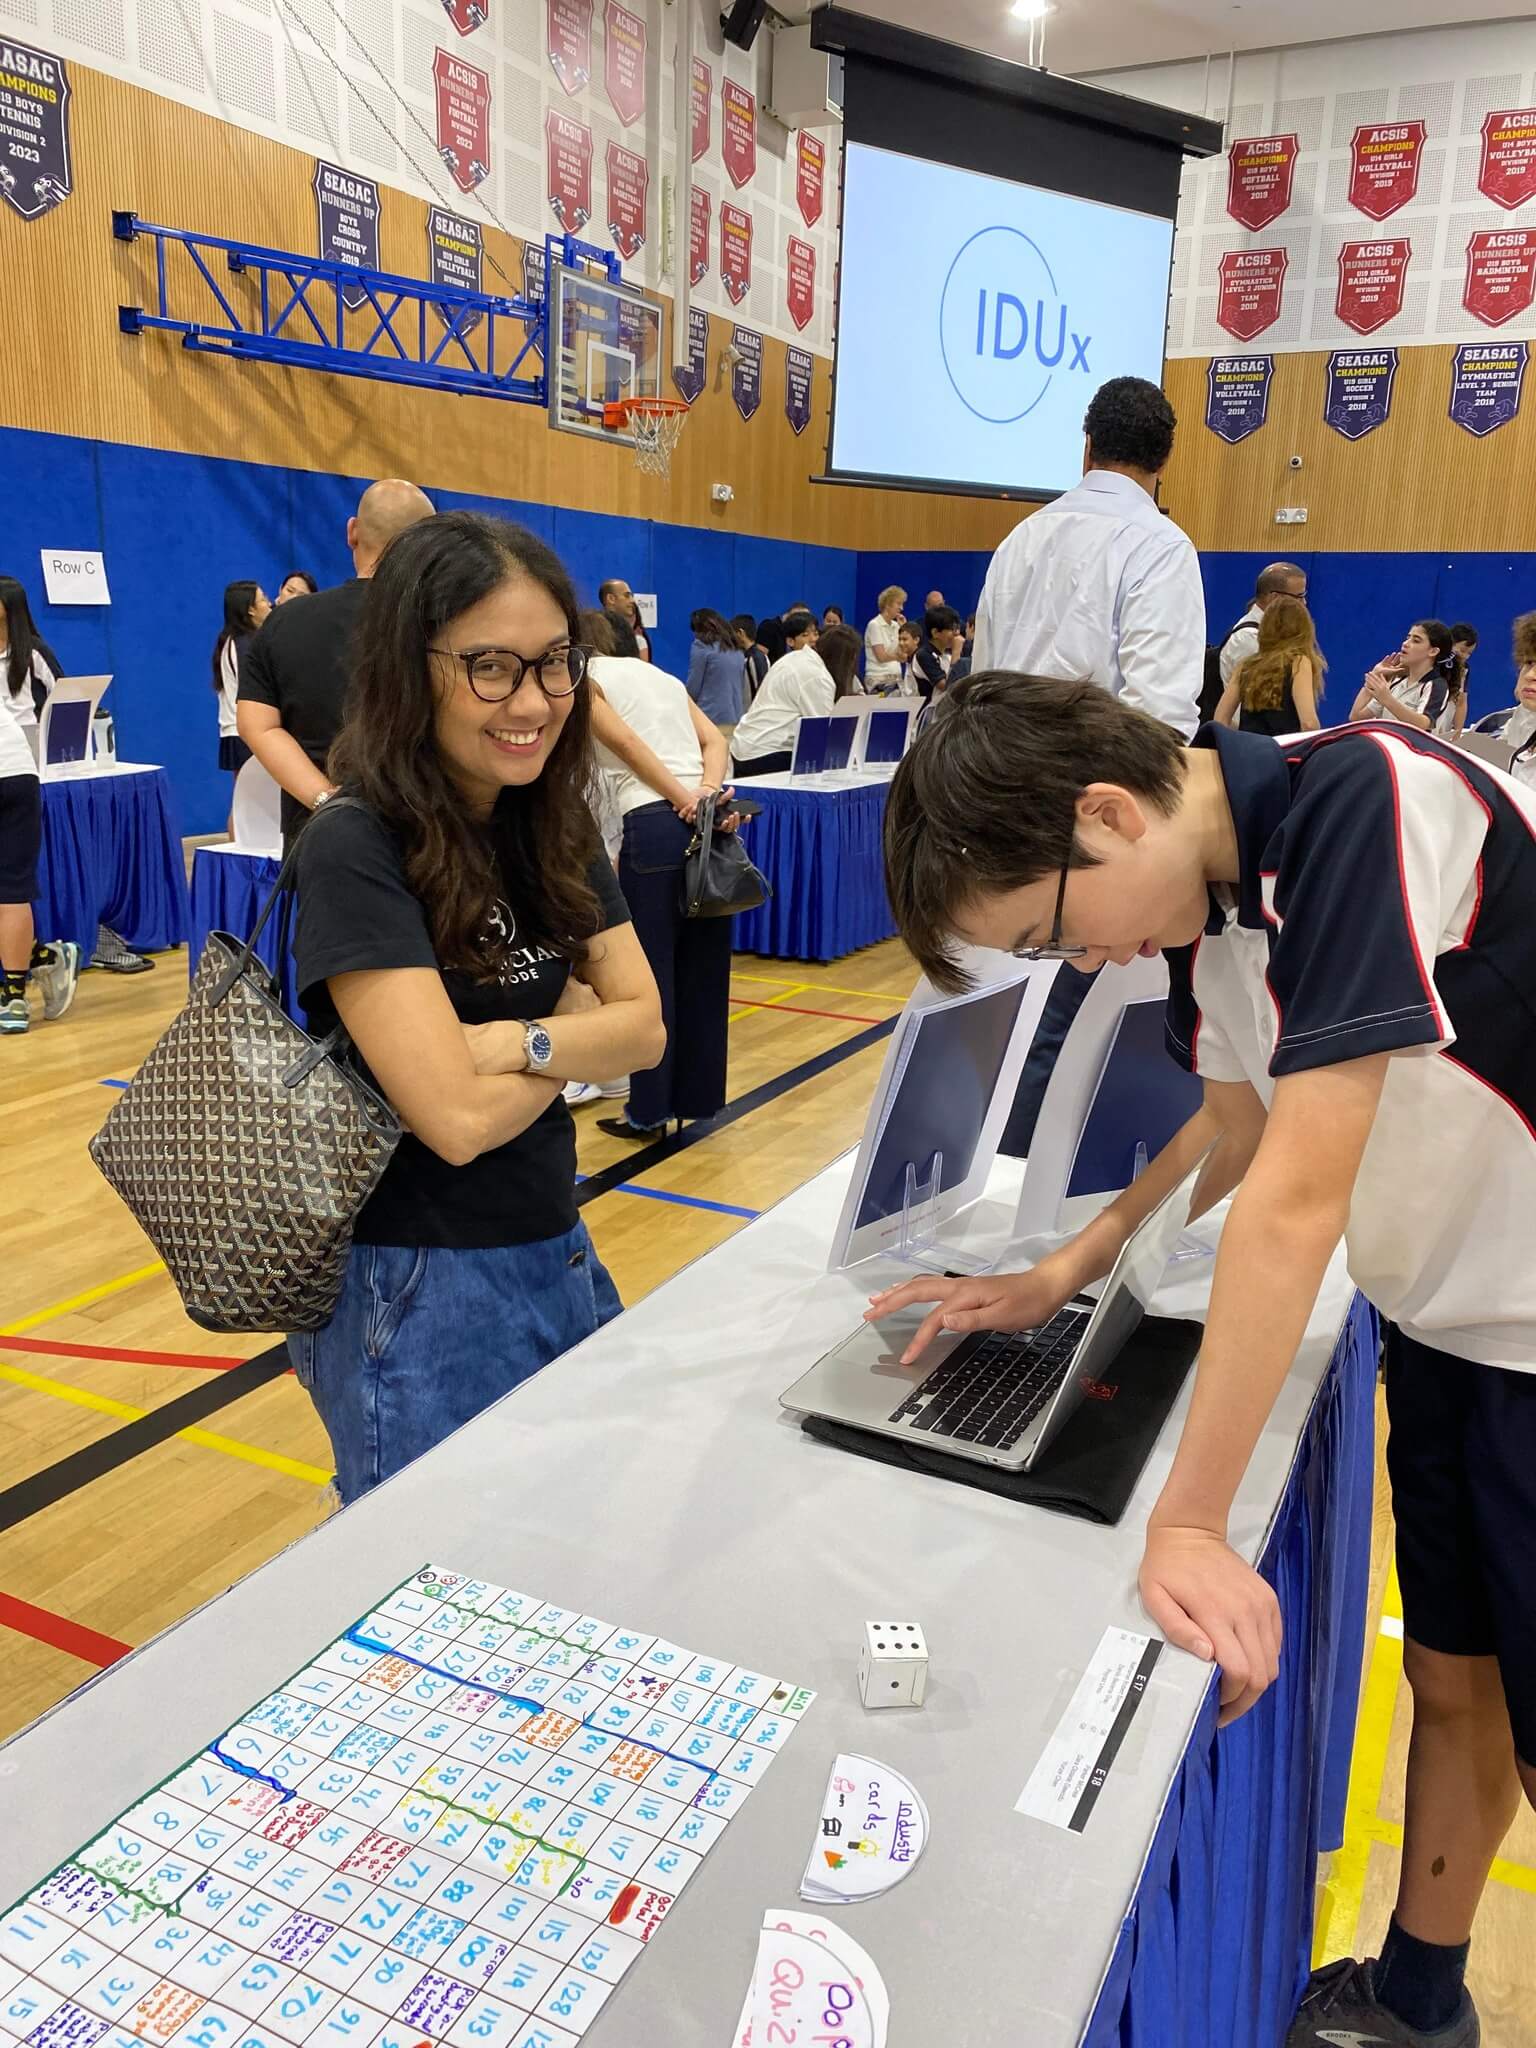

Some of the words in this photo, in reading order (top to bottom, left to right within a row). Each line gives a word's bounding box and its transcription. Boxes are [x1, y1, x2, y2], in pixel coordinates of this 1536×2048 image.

[2, 48, 55, 83] ASAC
[448, 62, 478, 89] ACSIS
[0, 72, 57, 103] AMPIONS
[15, 96, 44, 116] BOYS
[0, 106, 41, 129] TENNIS
[40, 137, 46, 147] 2
[1369, 128, 1408, 142] ACSIS
[1492, 129, 1536, 140] CHAMPIO
[8, 142, 40, 163] 2023
[1247, 142, 1282, 155] ACSIS
[1361, 142, 1415, 154] CHAMPIONS
[1490, 149, 1536, 160] VOLLEYBA
[1239, 154, 1288, 166] CHAMPIONS
[1359, 161, 1413, 172] VOLLEYBALL
[1241, 174, 1280, 184] SOFTBALL
[1506, 166, 1526, 176] 2019
[324, 171, 372, 204] SEASAC
[321, 191, 362, 216] RUNNERS
[363, 206, 375, 220] UP
[338, 222, 361, 239] CROSS
[435, 215, 476, 243] SEASAC
[332, 235, 368, 255] COUNTRY
[1487, 234, 1527, 248] ACSIS
[528, 250, 545, 267] SEA
[1236, 255, 1271, 267] ACSIS
[1357, 245, 1394, 258] ACSIS
[1474, 249, 1520, 259] RUNNERS
[1523, 247, 1536, 256] UP
[437, 258, 477, 280] VOLLEYBALL
[1225, 268, 1265, 278] RUNNERS
[1269, 267, 1280, 275] UP
[1345, 259, 1387, 269] RUNNERS
[1391, 258, 1402, 266] UP
[1477, 265, 1529, 275] BADMINTON
[1348, 275, 1396, 285] BADMINTON
[1490, 285, 1510, 294] 2019
[976, 288, 1092, 374] IDUx
[1337, 354, 1388, 367] SEASAC
[1464, 348, 1519, 361] SEASAC
[1217, 360, 1265, 373] SEASAC
[1336, 367, 1387, 377] CHAMPIONS
[1462, 361, 1518, 371] CHAMPIONS
[1462, 372, 1515, 380] GYMNASTICS
[1216, 374, 1264, 382] CHAMPIONS
[1216, 390, 1261, 398] VOLLEYBALL
[53, 560, 80, 574] Row
[85, 561, 95, 575] C
[443, 1651, 476, 1673] 29
[486, 1665, 510, 1683] 50
[300, 1681, 333, 1694] 4
[416, 1675, 446, 1698] 30
[340, 1691, 372, 1710] 22
[381, 1705, 413, 1722] 31
[604, 1706, 630, 1726] 83
[310, 1720, 339, 1738] 21
[579, 1734, 606, 1753] 84
[272, 1753, 307, 1778] 20
[392, 1752, 416, 1774] 47
[497, 1748, 530, 1765] 76
[201, 1775, 223, 1796] 7
[319, 1773, 353, 1793] 33
[438, 1766, 464, 1785] 58
[548, 1766, 573, 1785] 85
[663, 1767, 688, 1787] 119
[472, 1781, 501, 1801] 75
[636, 1798, 663, 1820] 118
[863, 1780, 887, 1830] cards
[404, 1807, 432, 1832] 59
[558, 1811, 588, 1837] 103
[195, 1828, 225, 1849] 19
[318, 1826, 350, 1846] 45
[436, 1823, 468, 1846] 74
[483, 1837, 506, 1861] 87
[608, 1836, 634, 1861] 117
[157, 1863, 187, 1882] 18
[272, 1867, 308, 1891] 44
[394, 1861, 430, 1888] 73
[196, 1875, 214, 1893] top
[442, 1880, 474, 1903] 88
[571, 1877, 592, 1898] top
[594, 1879, 620, 1901] 116
[104, 1903, 131, 1926] 17
[360, 1898, 401, 1929] 72
[658, 1896, 672, 1913] go
[238, 1902, 272, 1928] 43
[9, 1914, 48, 1941] 11
[539, 1920, 571, 1943] 115
[155, 1928, 189, 1951] 36
[60, 1948, 90, 1969] 16
[330, 1942, 362, 1966] 71
[459, 1936, 493, 1967] 100
[581, 1942, 609, 1971] 129
[241, 1964, 278, 1991] 63
[375, 1958, 404, 1984] 90
[99, 1978, 134, 2006] 37
[281, 1985, 324, 2018] 70
[550, 1981, 586, 2016] 128
[8, 1998, 39, 2019] 15
[468, 2008, 501, 2036] 113
[186, 2017, 227, 2048] 64
